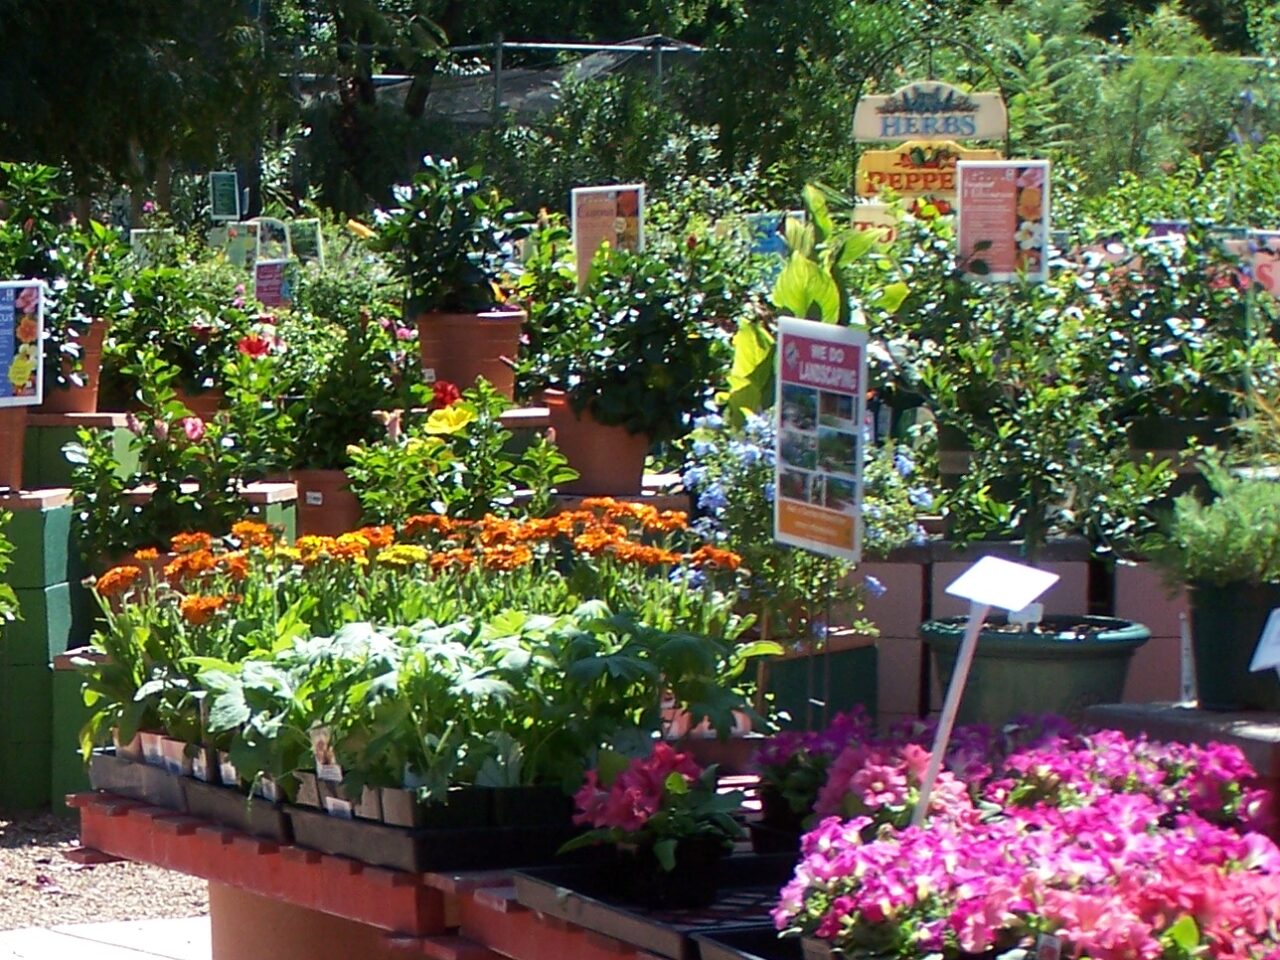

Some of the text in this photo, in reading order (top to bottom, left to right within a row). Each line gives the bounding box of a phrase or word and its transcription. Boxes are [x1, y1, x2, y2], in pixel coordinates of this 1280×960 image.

[879, 114, 976, 138] HERBS
[866, 170, 955, 194] PEPPE
[810, 343, 845, 364] WE DO
[798, 360, 858, 391] LANDSCAPING
